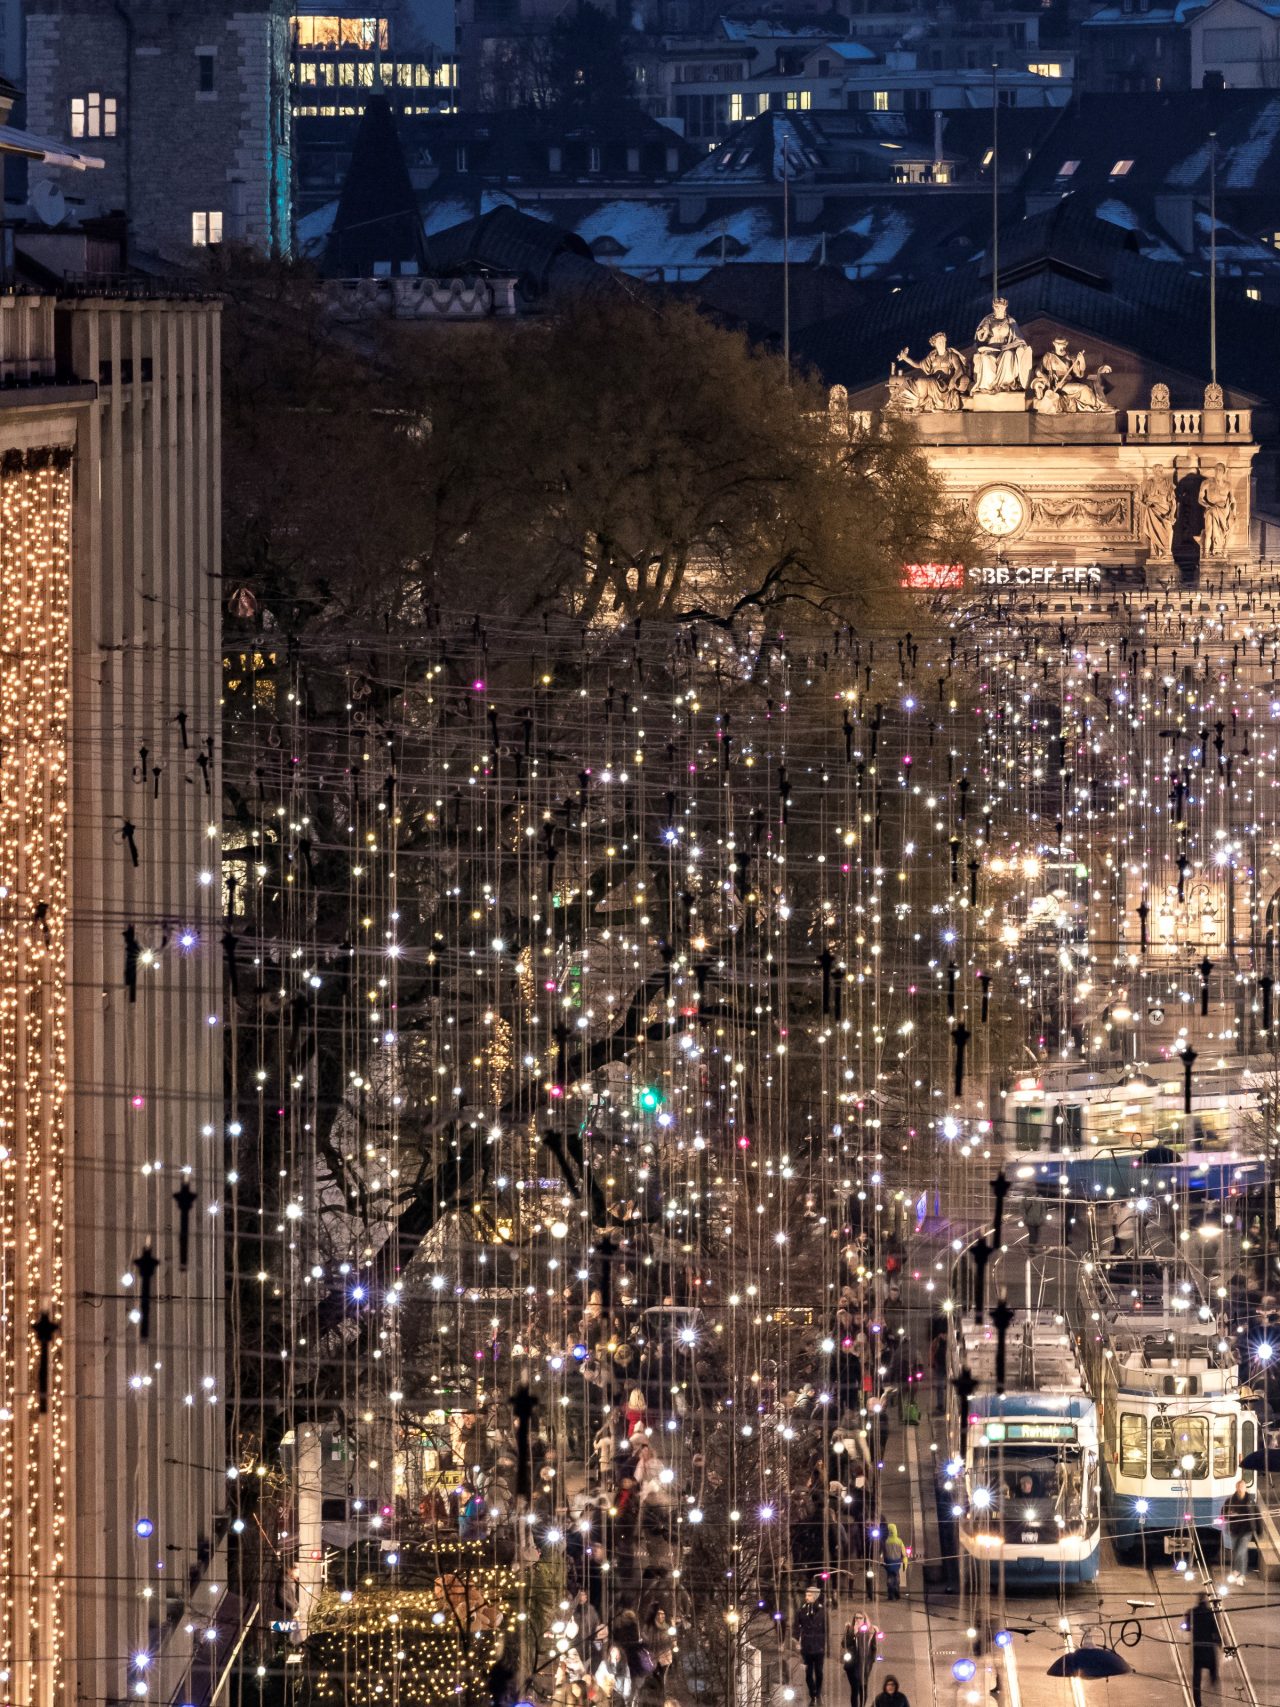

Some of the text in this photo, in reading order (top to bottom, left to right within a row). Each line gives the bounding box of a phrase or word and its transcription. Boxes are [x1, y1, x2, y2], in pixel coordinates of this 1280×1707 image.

[968, 567, 1101, 584] SBB CFF FFS
[1174, 1377, 1187, 1394] 7
[279, 1621, 297, 1631] WC
